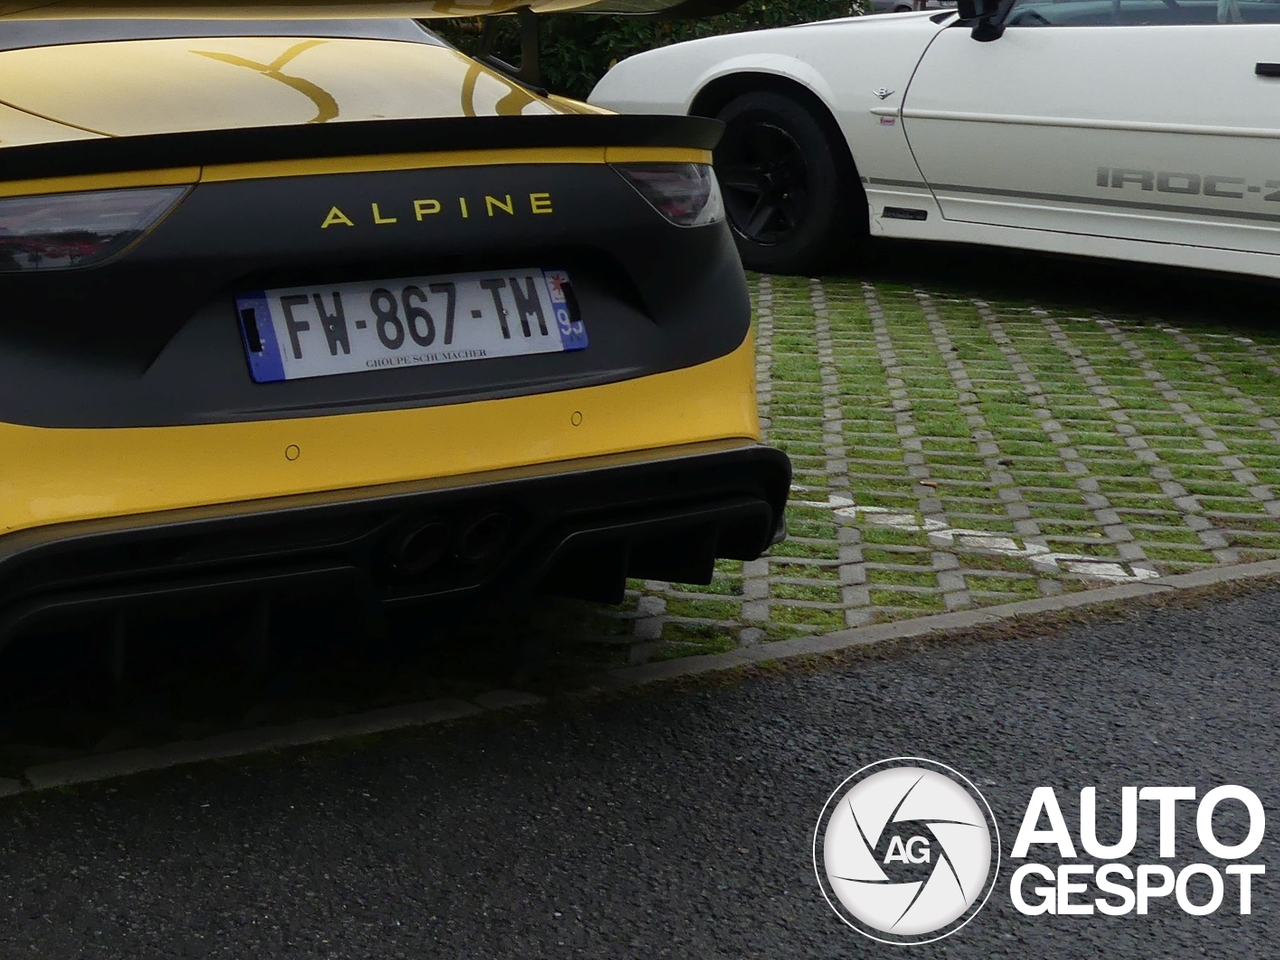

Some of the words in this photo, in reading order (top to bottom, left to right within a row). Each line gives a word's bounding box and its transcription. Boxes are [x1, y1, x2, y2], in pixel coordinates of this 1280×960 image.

[321, 193, 553, 228] ALPINE
[280, 277, 549, 359] FW-867-TM
[366, 356, 410, 368] GROUPE
[413, 349, 487, 364] SCHUMACHER
